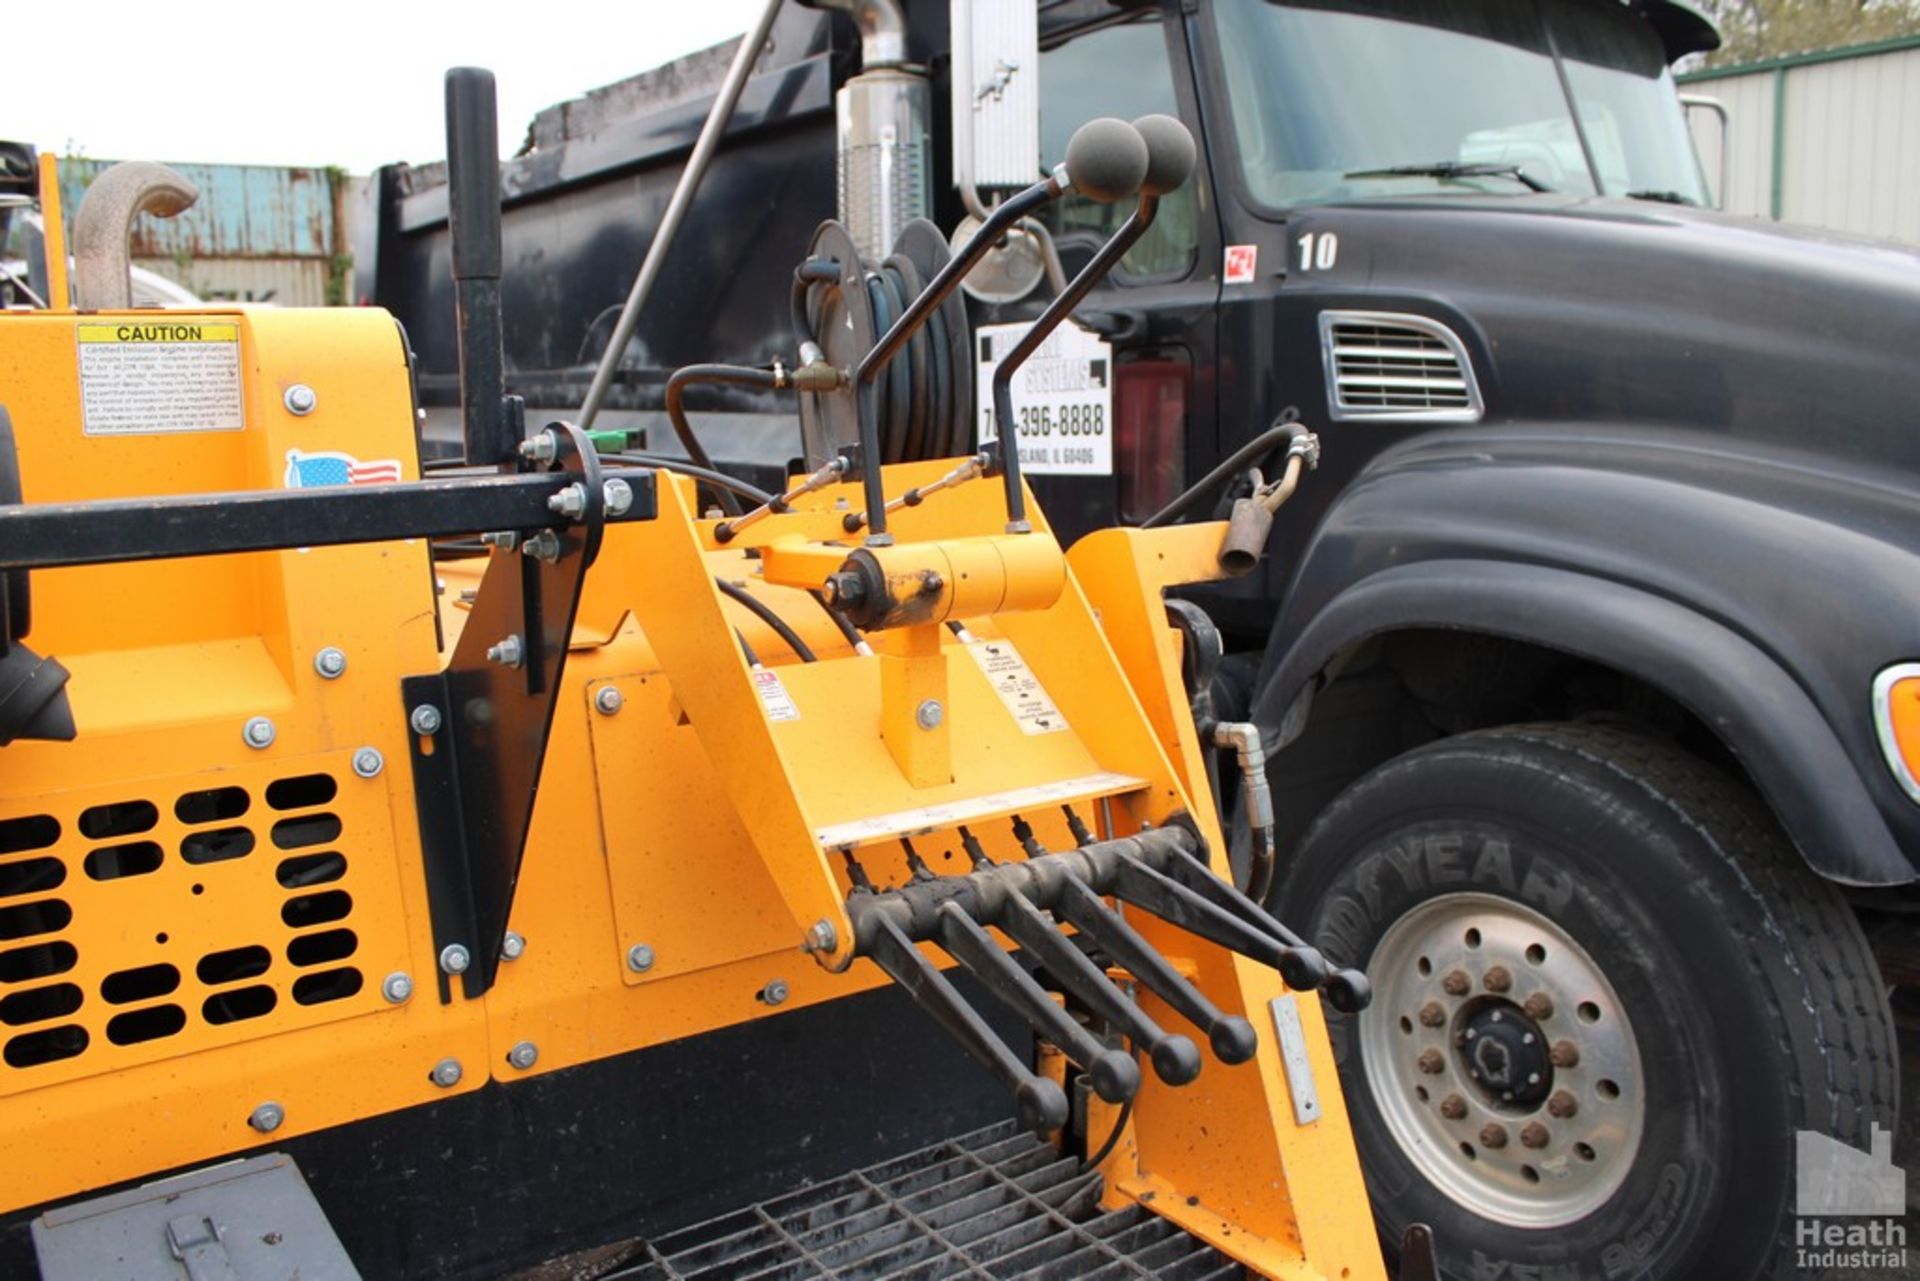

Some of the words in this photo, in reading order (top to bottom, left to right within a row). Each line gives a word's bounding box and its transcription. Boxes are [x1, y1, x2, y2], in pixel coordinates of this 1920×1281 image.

[1297, 232, 1338, 271] 10
[117, 326, 202, 341] CAUTION
[984, 404, 1104, 438] 7-396-8888
[1018, 447, 1050, 466] SLAND,
